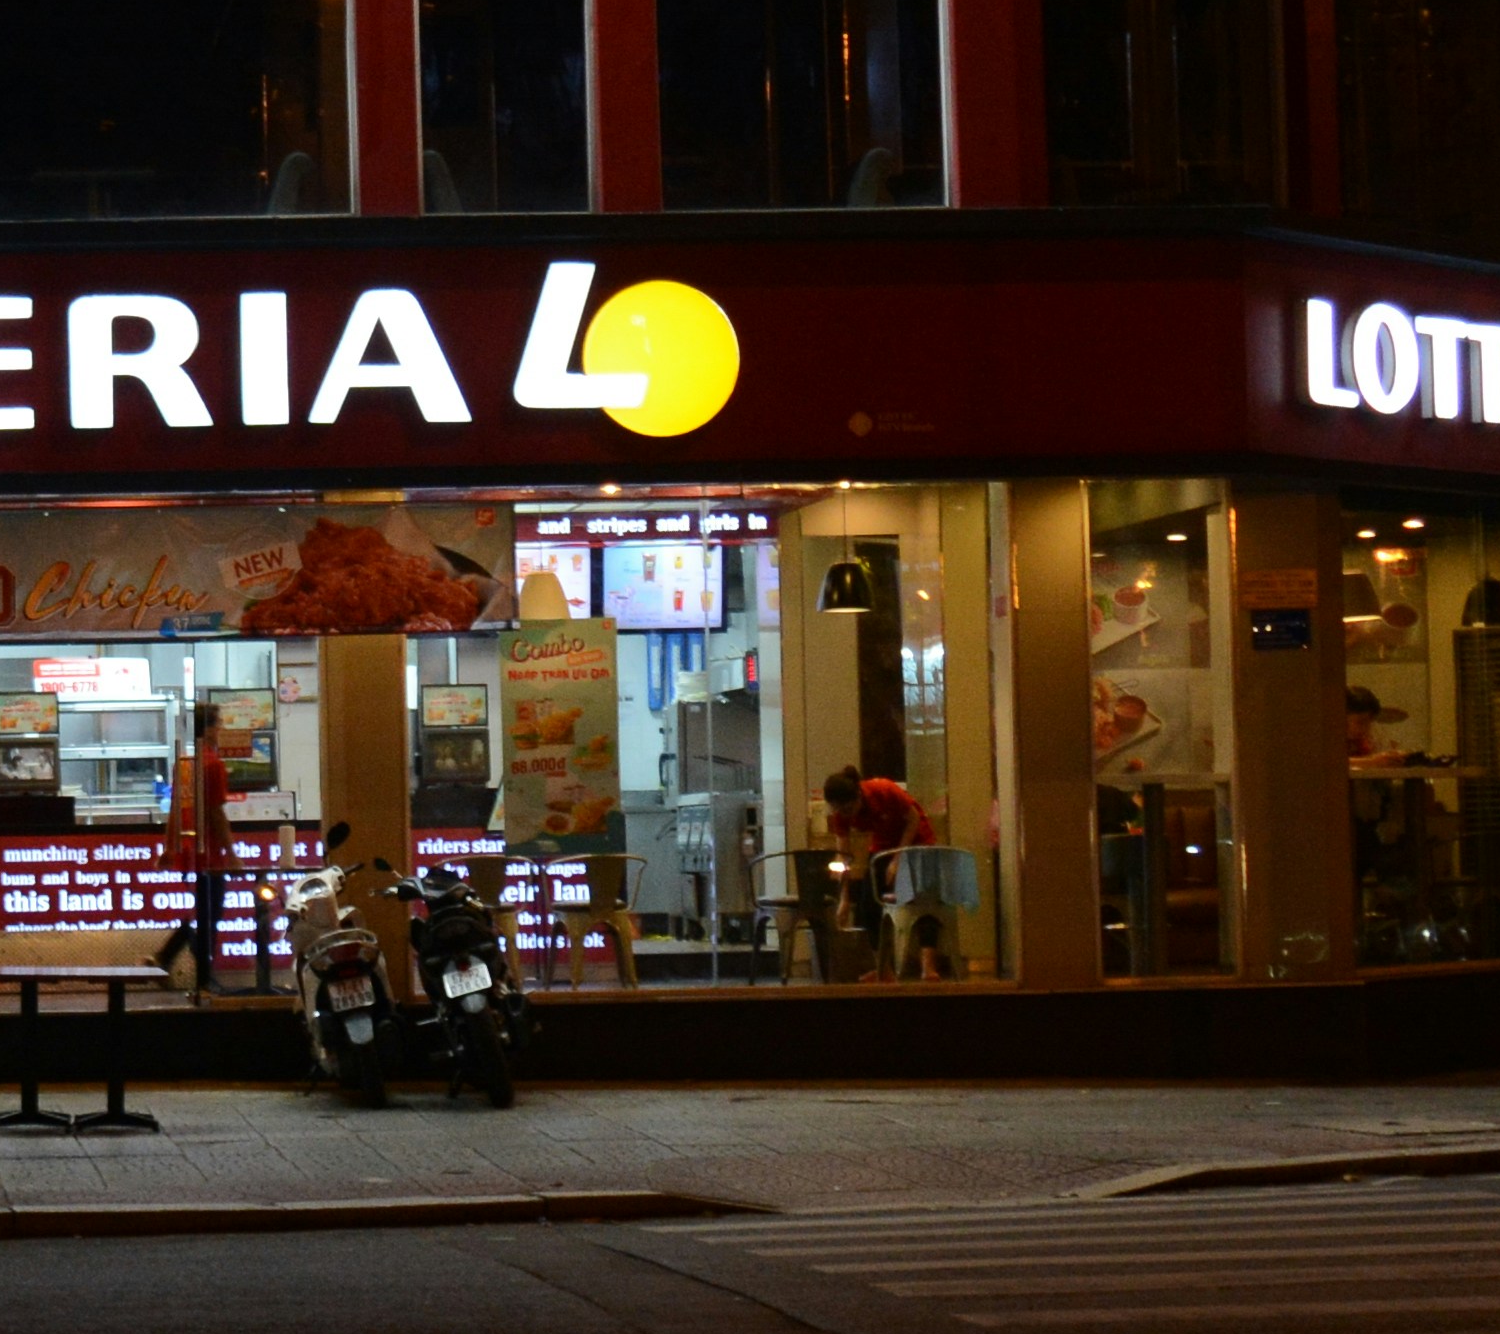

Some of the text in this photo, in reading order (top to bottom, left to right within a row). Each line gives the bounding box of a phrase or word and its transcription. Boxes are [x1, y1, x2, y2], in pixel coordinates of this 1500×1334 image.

[537, 516, 571, 535] and
[586, 517, 648, 536] stripes
[655, 513, 690, 533] and
[747, 513, 768, 531] in
[233, 546, 285, 579] NEW
[23, 555, 208, 629] Chicken
[510, 633, 586, 663] Combo
[2, 845, 88, 864] munching
[93, 843, 151, 861] sliders
[416, 837, 469, 855] riders
[0, 872, 36, 886] buns
[41, 870, 70, 886] and
[74, 870, 109, 887] boys
[114, 870, 131, 884] in
[2, 890, 51, 913] this
[58, 888, 113, 912] land
[121, 888, 144, 911] is
